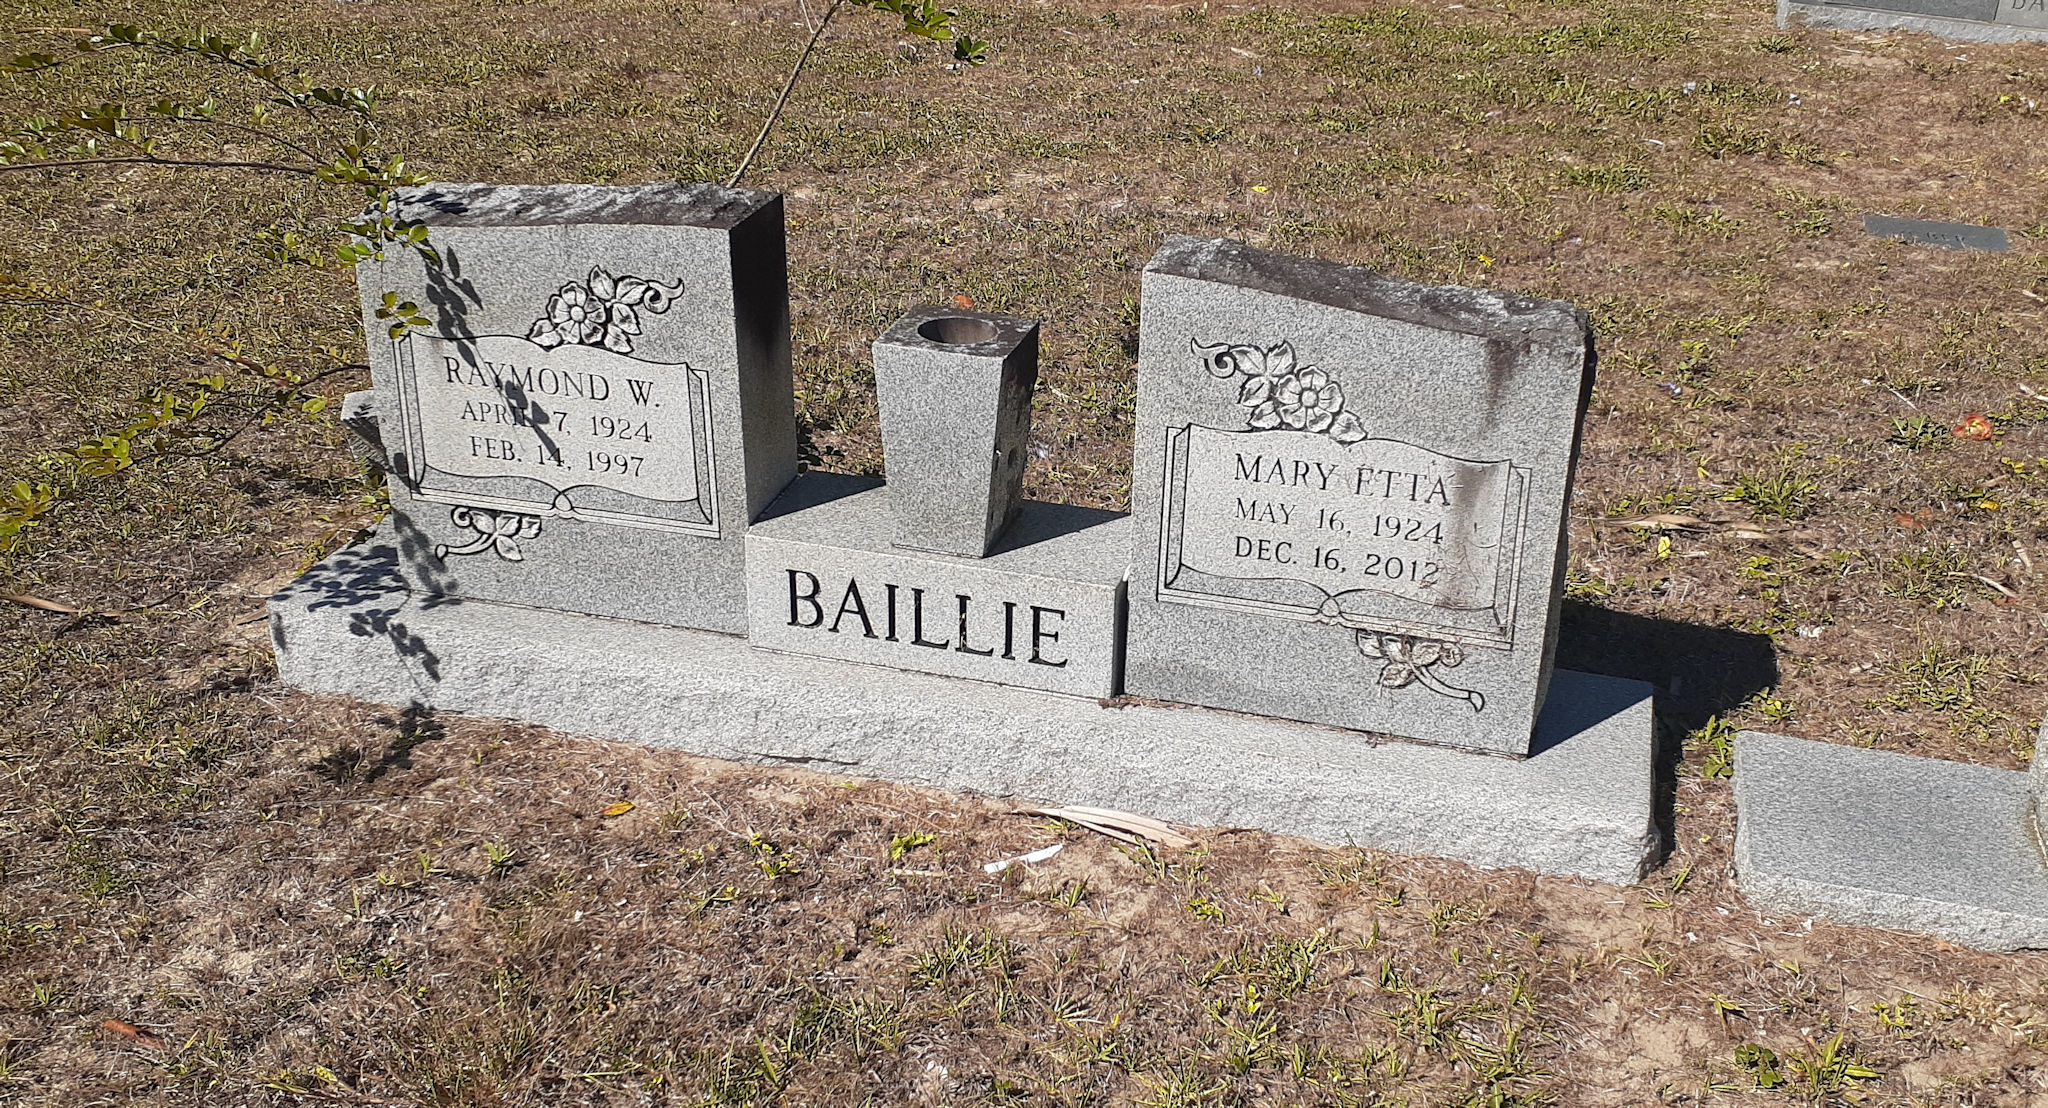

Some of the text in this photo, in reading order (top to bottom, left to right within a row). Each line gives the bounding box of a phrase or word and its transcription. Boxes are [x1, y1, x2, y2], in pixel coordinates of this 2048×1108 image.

[443, 356, 660, 408] RAYMOND W.
[460, 401, 653, 443] APRIL 7, 1924
[469, 435, 645, 477] FEB. 14, 1997
[1234, 453, 1451, 506] MARY ETTA
[1235, 497, 1444, 545] MAY 16, 1924
[1235, 535, 1440, 584] DEC. 16, 2012
[785, 568, 1069, 668] BAILLIE
